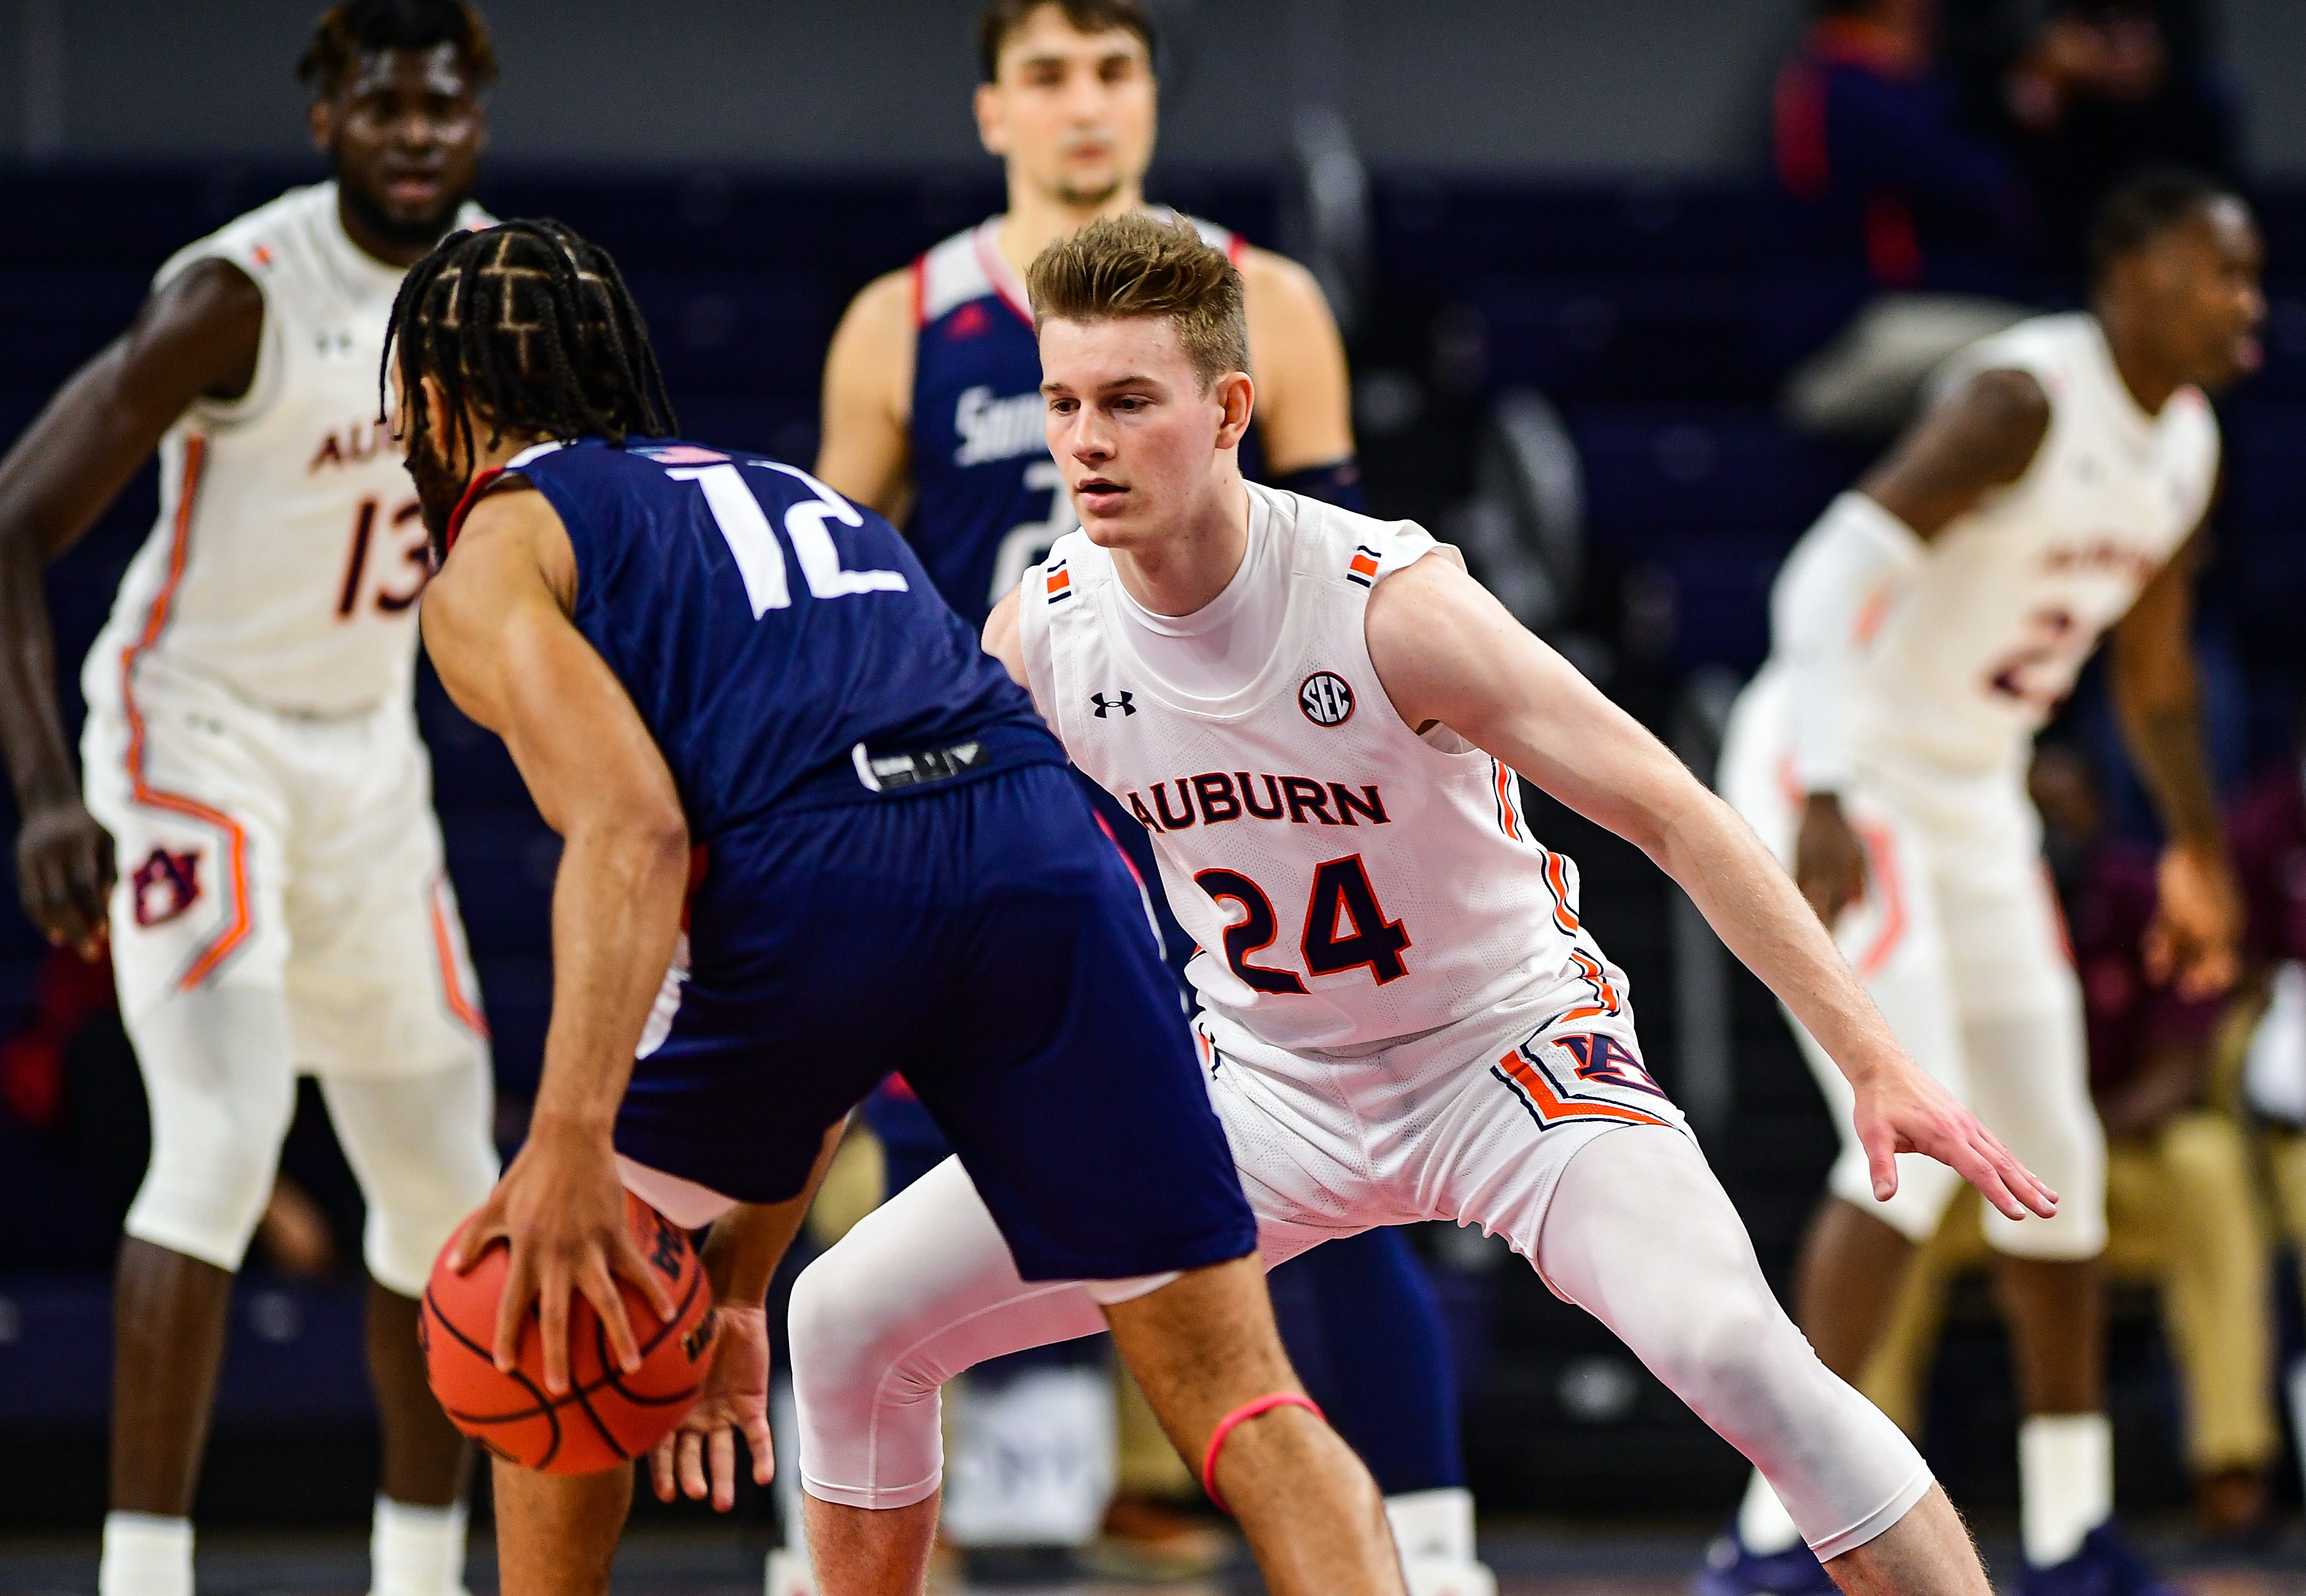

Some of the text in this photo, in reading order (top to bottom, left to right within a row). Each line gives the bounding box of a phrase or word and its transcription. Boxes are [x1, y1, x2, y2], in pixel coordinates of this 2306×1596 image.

[335, 494, 431, 621] 13
[664, 459, 910, 621] 12
[1302, 675, 1350, 723] SEC
[1127, 772, 1392, 834] AUBURN
[1193, 853, 1413, 995] 24
